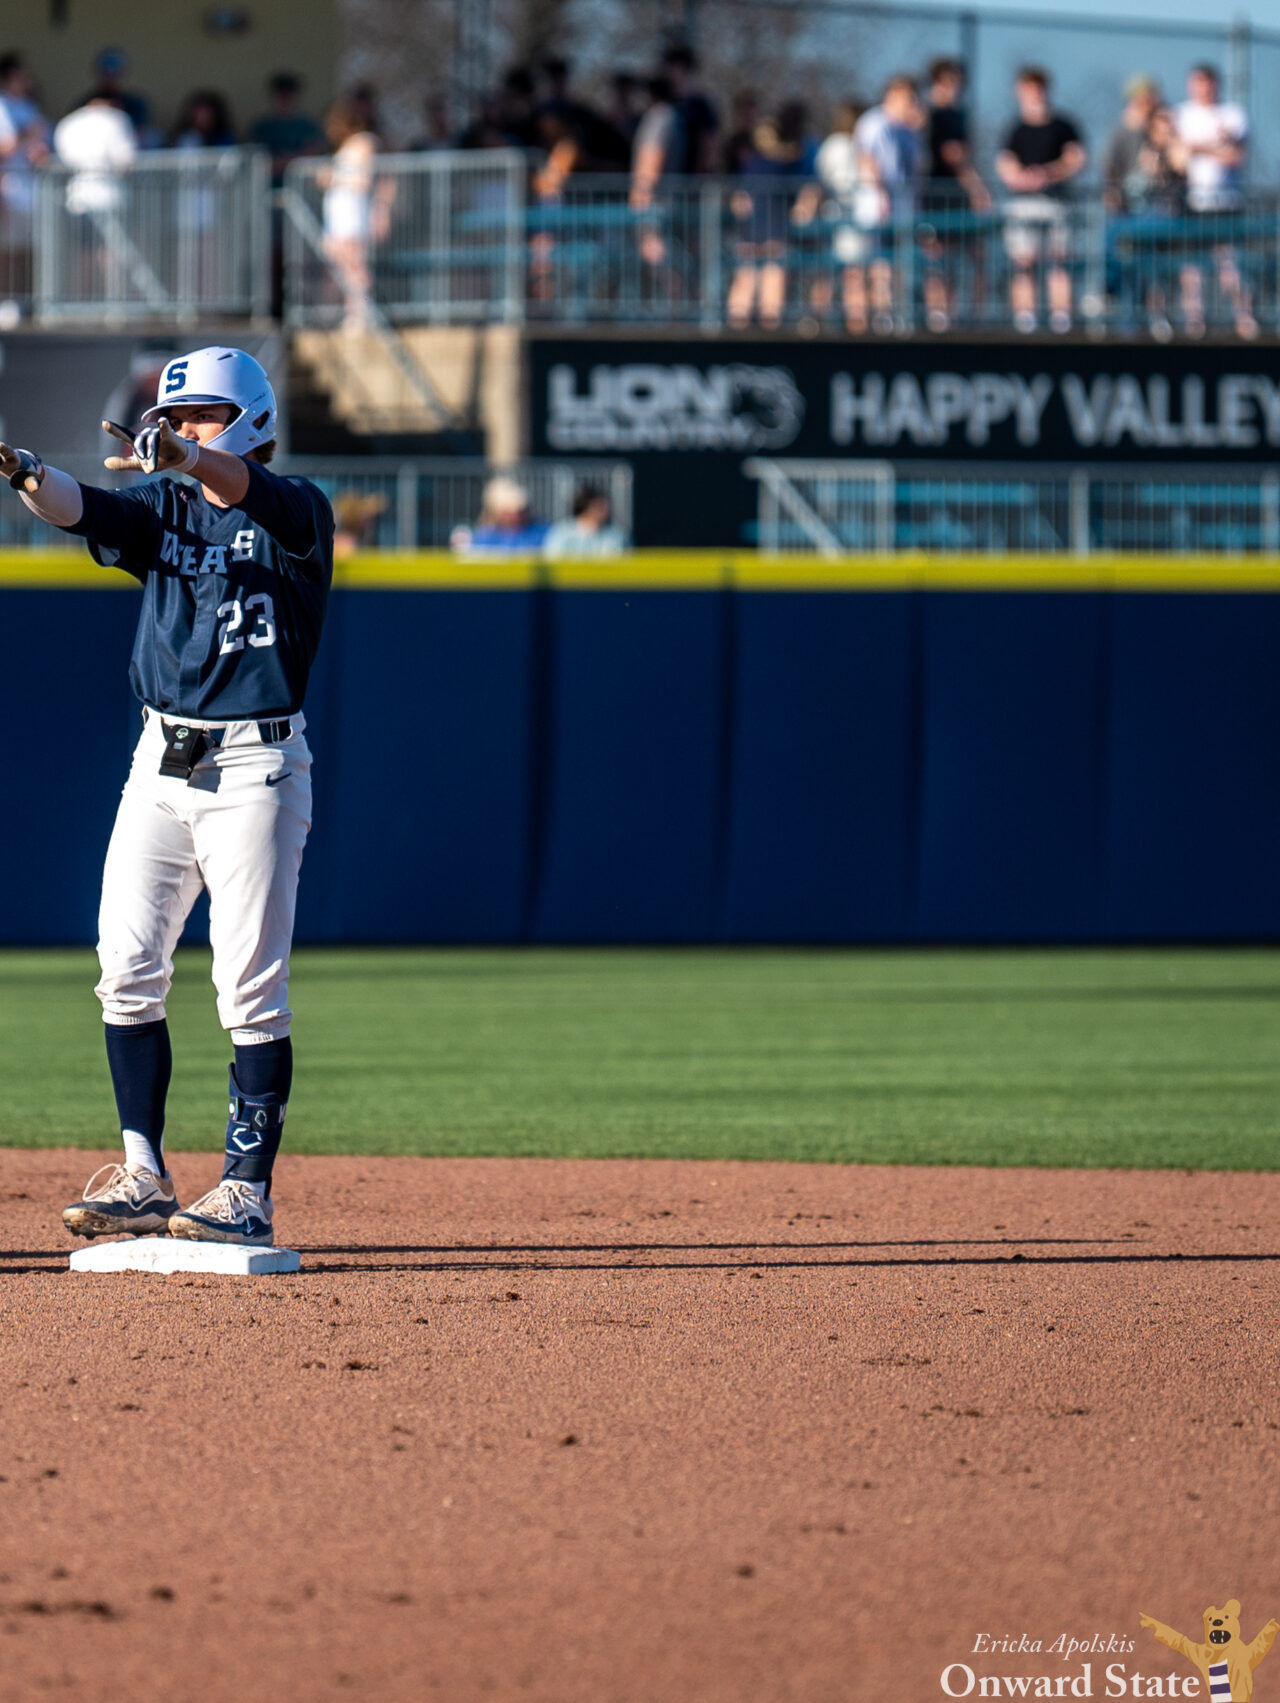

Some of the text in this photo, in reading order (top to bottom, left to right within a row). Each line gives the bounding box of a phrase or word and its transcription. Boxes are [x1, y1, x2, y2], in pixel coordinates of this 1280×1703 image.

[165, 361, 189, 394] S
[830, 370, 1280, 449] HAPPY VALLEY
[217, 593, 277, 656] 23
